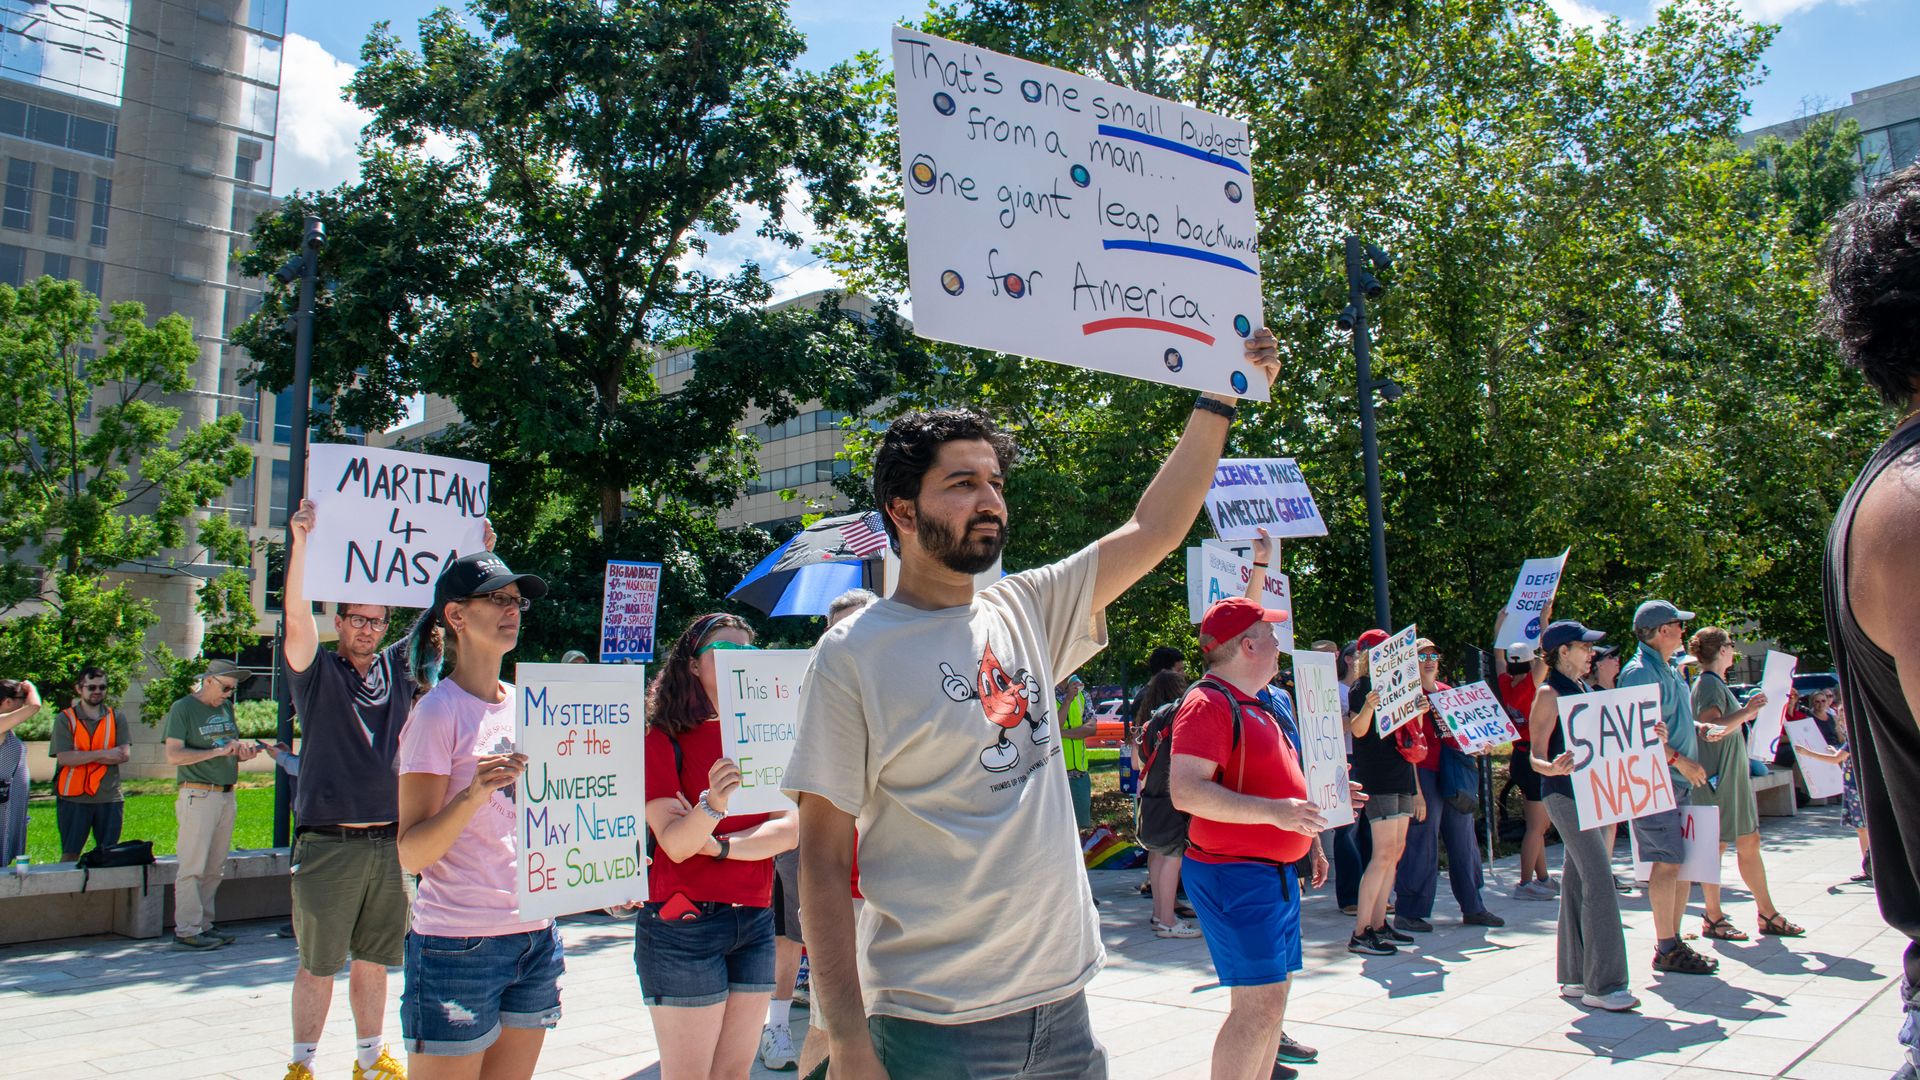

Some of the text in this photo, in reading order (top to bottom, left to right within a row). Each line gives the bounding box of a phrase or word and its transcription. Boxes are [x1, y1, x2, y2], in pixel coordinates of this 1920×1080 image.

[898, 39, 1249, 163] That's one small budget
[967, 107, 1037, 148] from
[1044, 131, 1067, 158] a
[908, 153, 978, 201] One
[997, 178, 1072, 229] giant
[1099, 187, 1160, 247] leap
[1073, 262, 1215, 326] America.
[336, 456, 487, 518] MARTIANS
[1265, 463, 1304, 484] MAKES
[389, 507, 427, 544] 4
[1216, 496, 1315, 529] AMERICA GREAT
[609, 564, 624, 578] BIG
[1241, 565, 1285, 597] SNCE
[633, 593, 655, 603] STEM
[1521, 591, 1539, 599] NOT
[604, 638, 652, 652] MOON
[1382, 636, 1404, 658] SAVE
[1375, 647, 1415, 678] SCIENCE
[732, 669, 768, 700] This
[775, 677, 790, 699] is
[1376, 686, 1407, 712] SCIENCE
[1438, 688, 1492, 711] SCIENCE
[524, 686, 630, 726] MYSTERIES
[1391, 699, 1415, 726] LIVES
[1454, 705, 1493, 726] SAVES
[557, 728, 611, 756] of the
[1302, 715, 1342, 762] NASA
[1464, 721, 1505, 740] LIVES
[1567, 700, 1660, 773] SAVE
[524, 762, 617, 803] UNIVERSE
[1590, 753, 1673, 820] NASA
[526, 806, 570, 849] MAY
[576, 802, 636, 842] NEVER
[528, 851, 557, 893] BE
